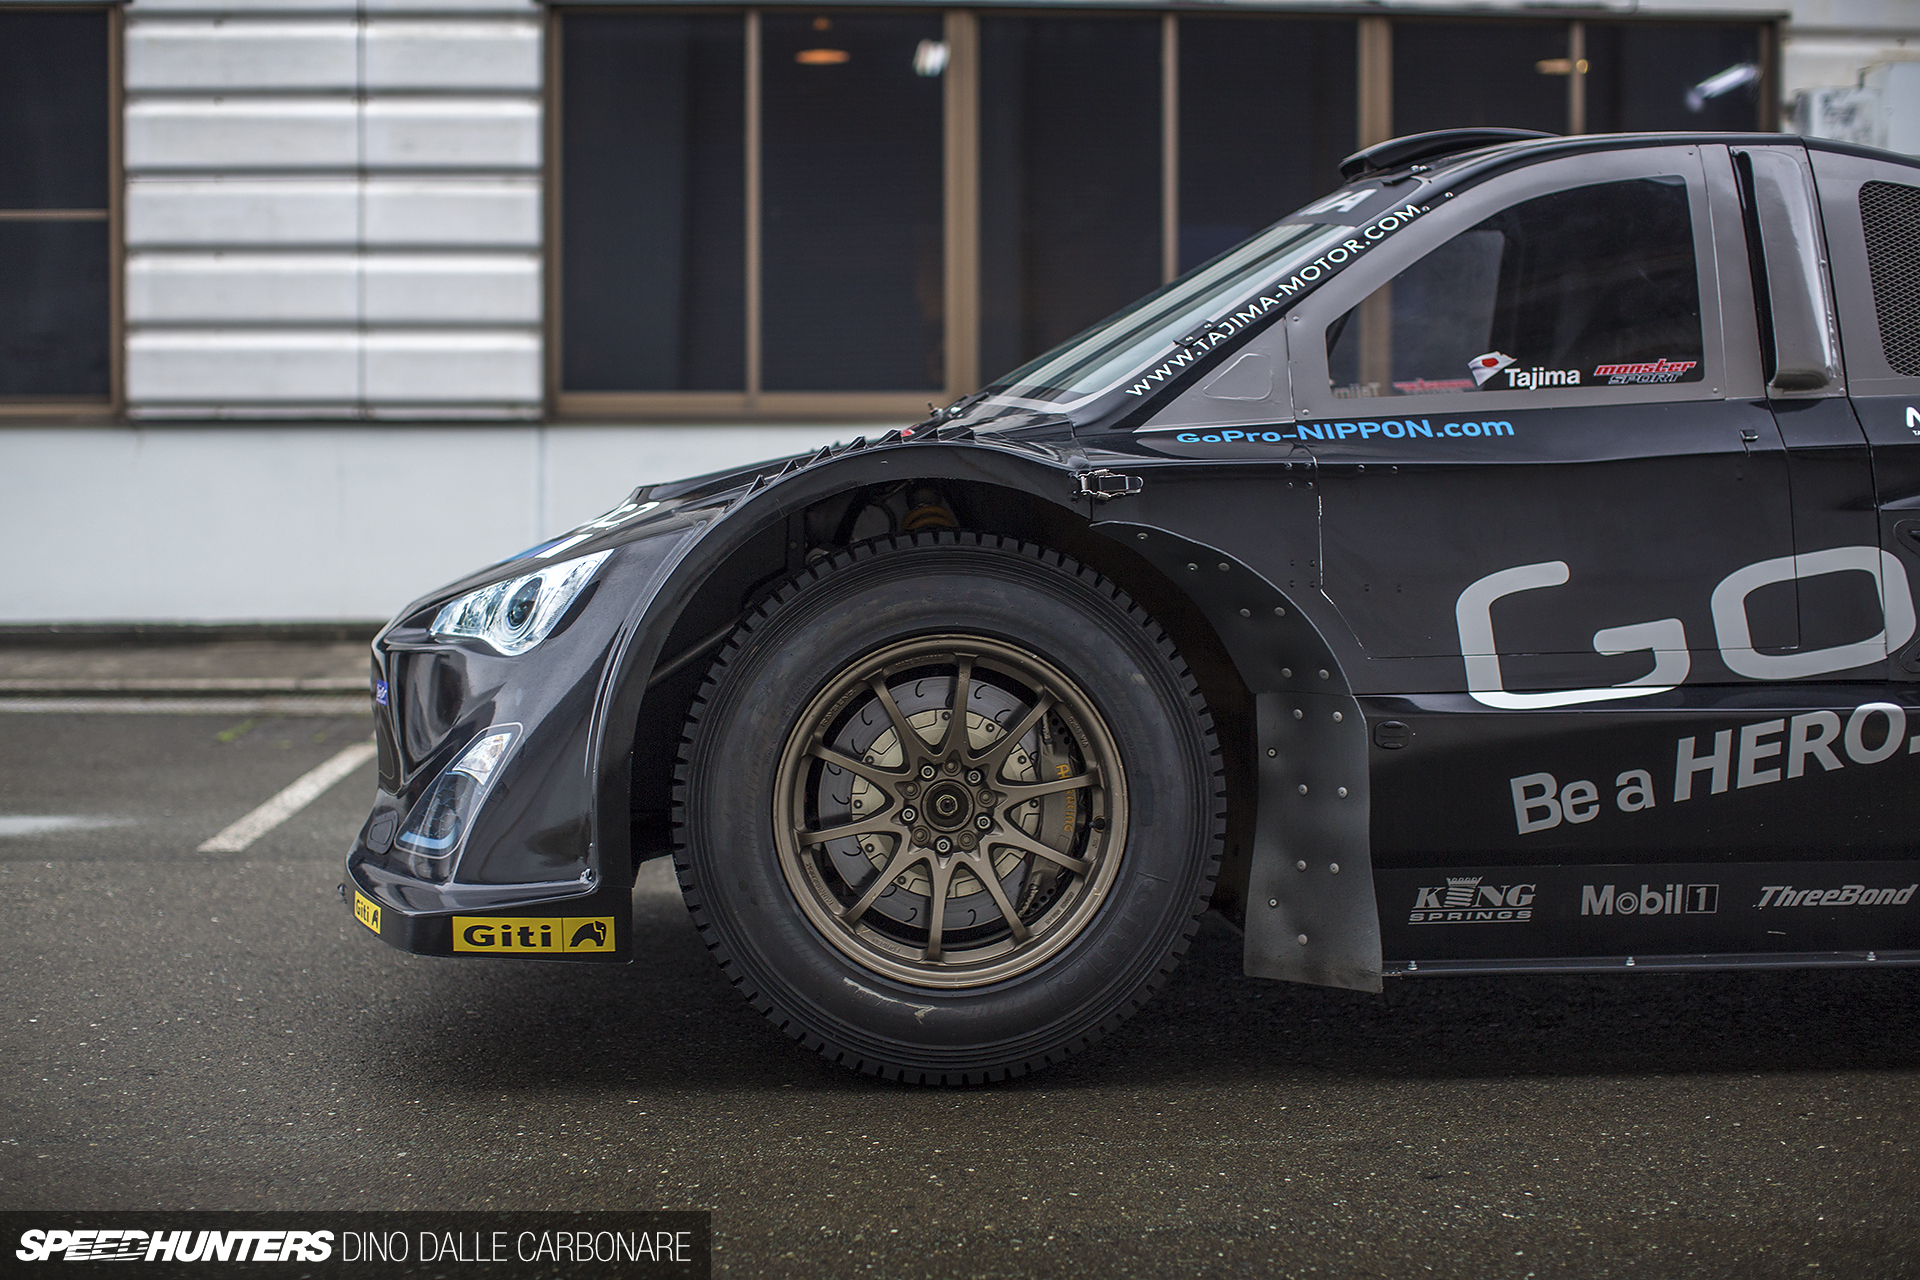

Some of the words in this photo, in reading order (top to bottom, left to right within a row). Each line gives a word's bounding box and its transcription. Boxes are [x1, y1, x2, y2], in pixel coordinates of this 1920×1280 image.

[1504, 366, 1581, 391] Tajima
[1593, 358, 1697, 377] monster
[1608, 372, 1682, 385] SPORT
[1176, 419, 1515, 444] GoPro-NIPPON.com
[1510, 772, 1600, 835] Be
[1616, 769, 1656, 812] a
[1581, 884, 1683, 915] Mobil
[1757, 884, 1919, 908] ThreeBond
[355, 899, 370, 920] Giti
[1409, 910, 1532, 922] SPRINGS
[463, 924, 552, 947] Giti
